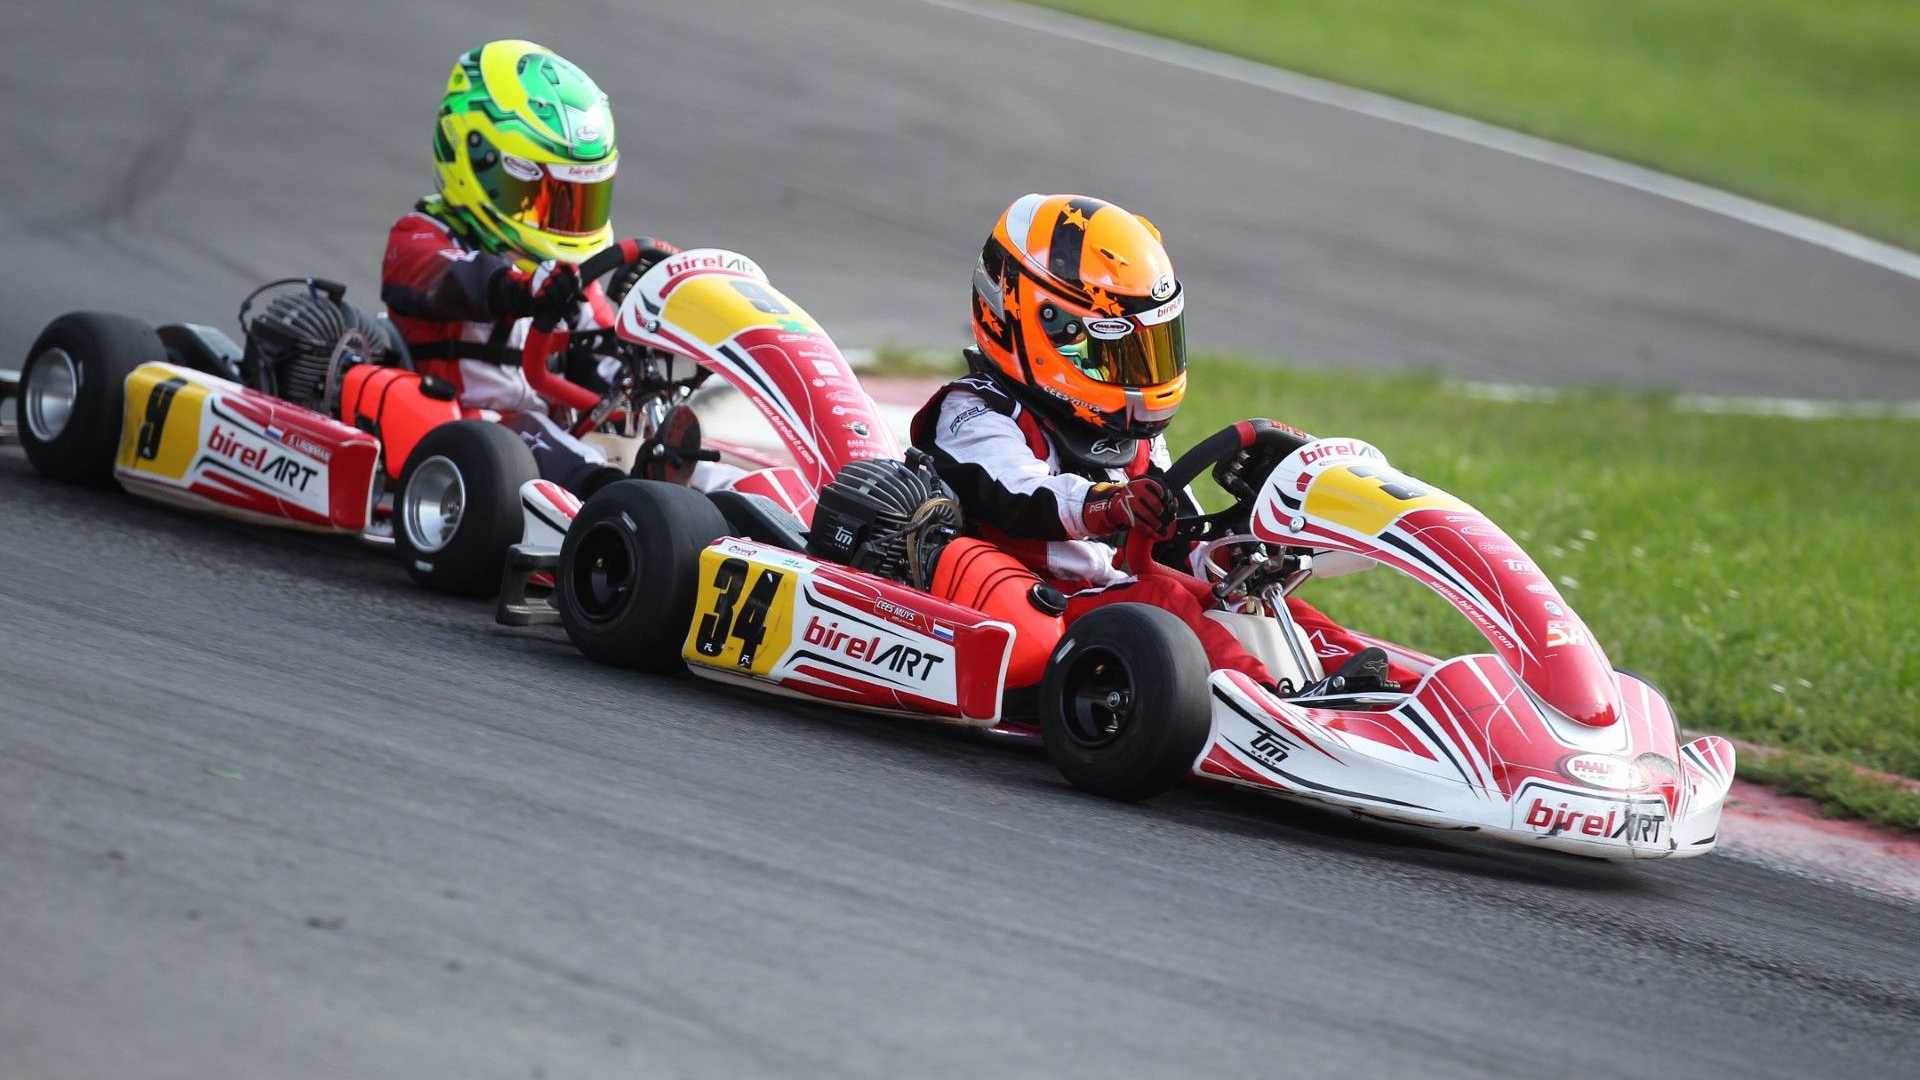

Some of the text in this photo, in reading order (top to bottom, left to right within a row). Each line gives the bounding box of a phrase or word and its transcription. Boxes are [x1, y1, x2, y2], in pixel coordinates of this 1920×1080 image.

[696, 557, 784, 669] 34
[876, 600, 894, 613] CEES
[894, 606, 916, 621] MUYS
[803, 615, 945, 682] birelART
